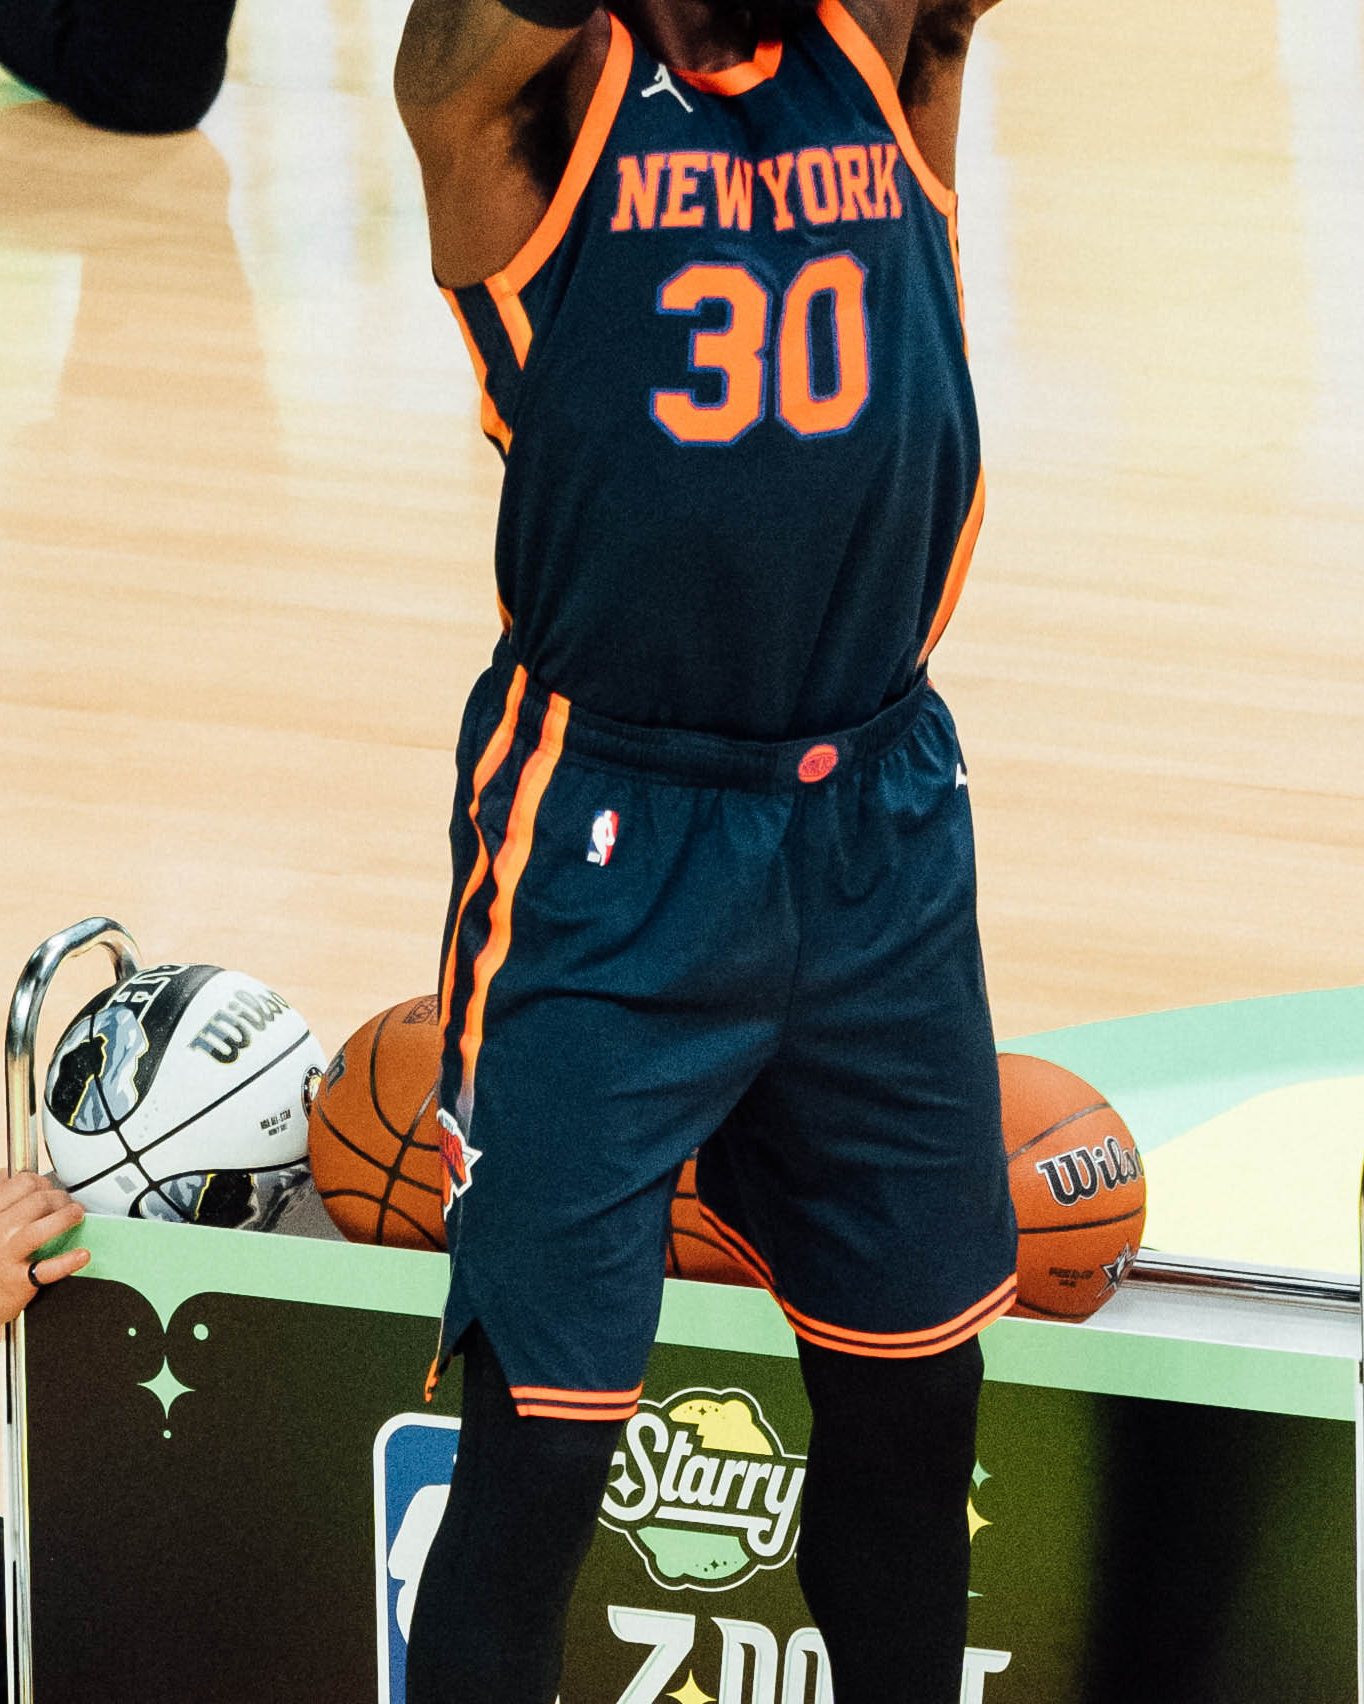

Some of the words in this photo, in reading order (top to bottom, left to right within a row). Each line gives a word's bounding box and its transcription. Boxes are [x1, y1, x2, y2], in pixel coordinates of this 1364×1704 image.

[610, 150, 754, 232] NEW
[757, 142, 903, 233] YORK
[648, 248, 872, 447] 30
[1035, 1135, 1145, 1207] Wils
[599, 1412, 806, 1558] Starry
